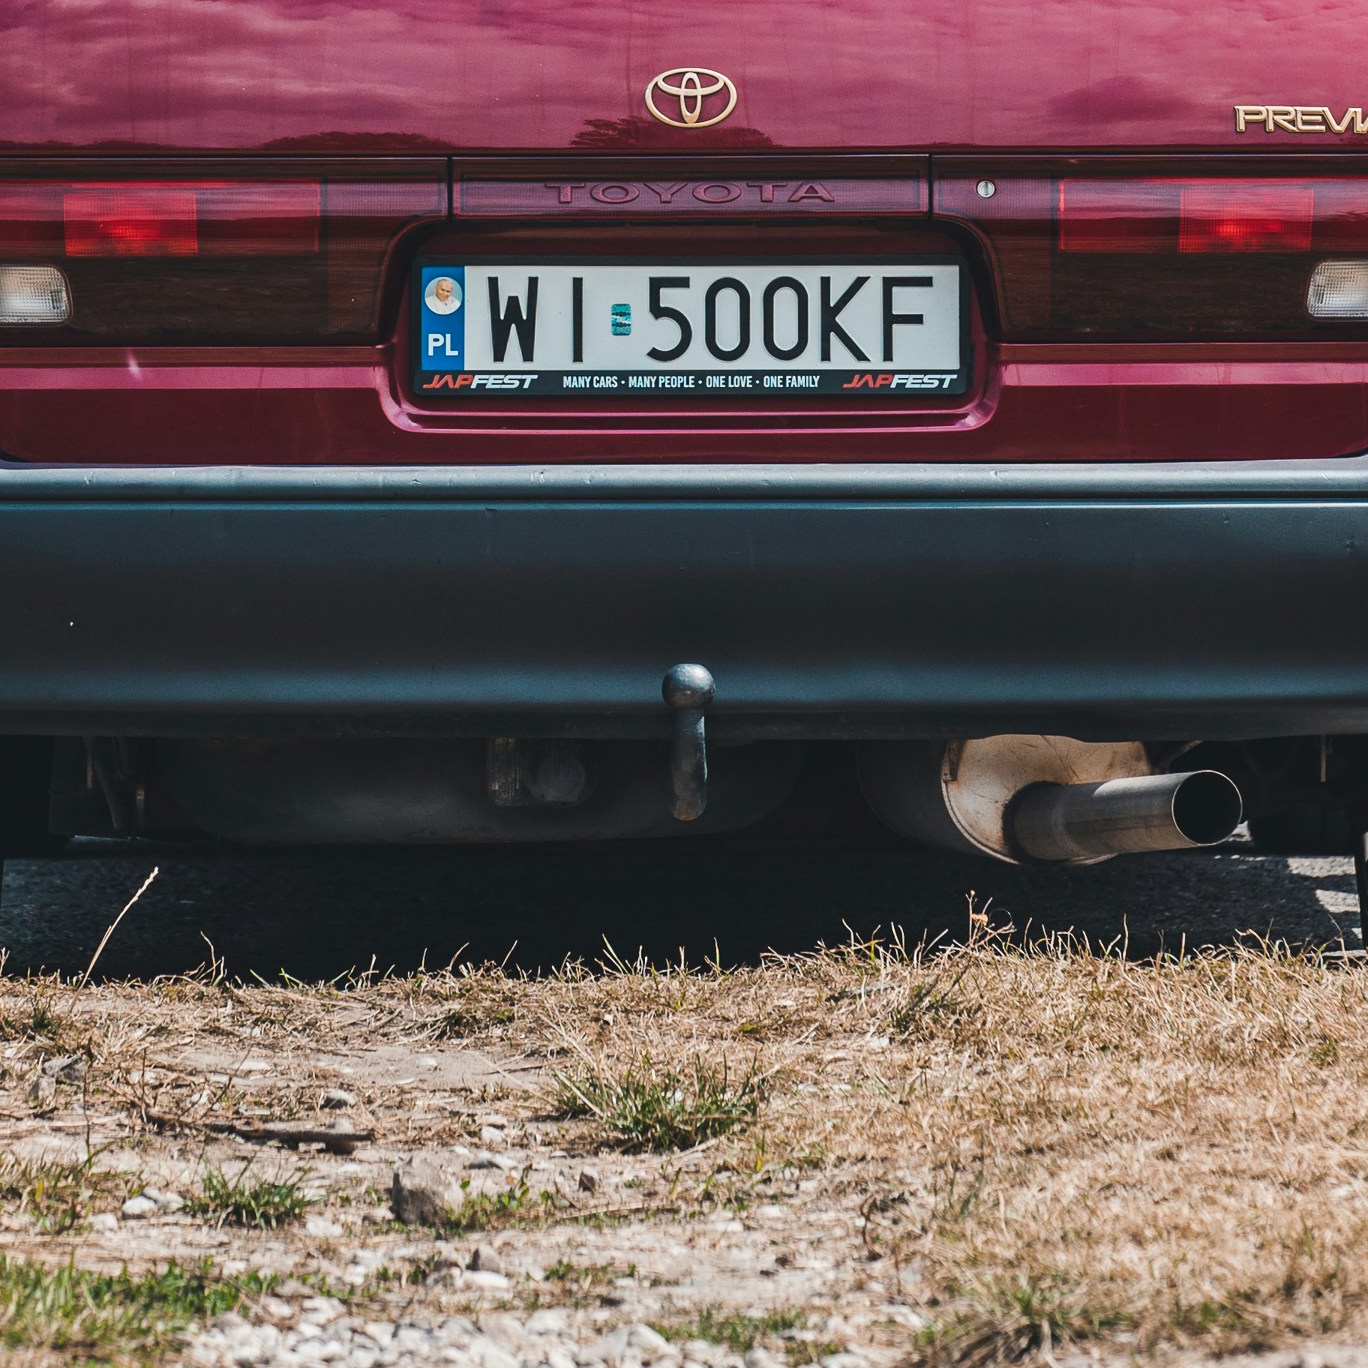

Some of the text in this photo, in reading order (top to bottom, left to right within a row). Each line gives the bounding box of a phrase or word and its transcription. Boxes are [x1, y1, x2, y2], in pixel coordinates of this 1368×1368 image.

[544, 181, 835, 205] TOYOTA
[486, 275, 934, 363] WI 500KF
[427, 334, 459, 358] PL
[422, 374, 539, 390] JAPFEST
[563, 375, 820, 389] MANY CARS MANY PEOPLE ONE LOVE ONE FAMILY
[843, 374, 959, 390] JAPFEST
